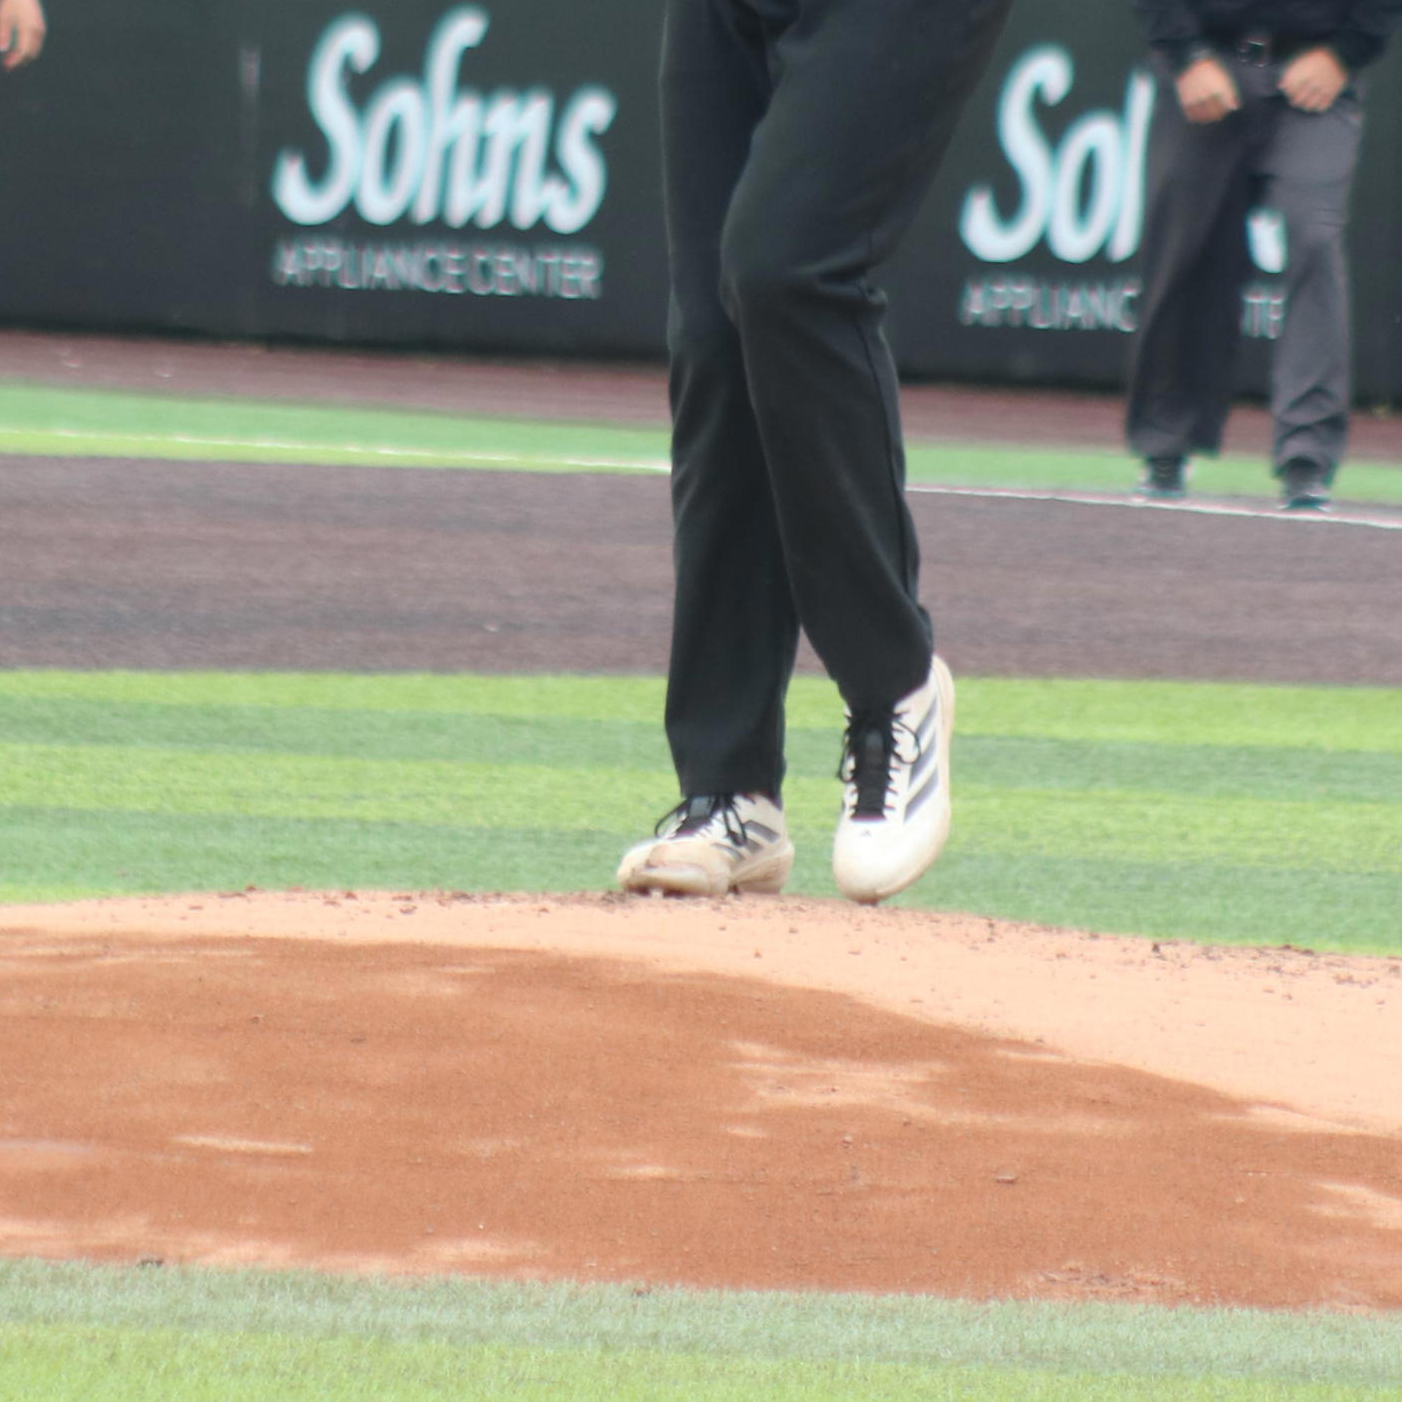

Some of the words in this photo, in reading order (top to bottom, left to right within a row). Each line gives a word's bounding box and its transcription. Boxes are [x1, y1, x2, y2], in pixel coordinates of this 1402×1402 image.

[272, 3, 618, 235] Sohns
[274, 237, 467, 295] APPLIANCE
[469, 245, 604, 300] CENTER
[959, 275, 1140, 335] APPLIANC
